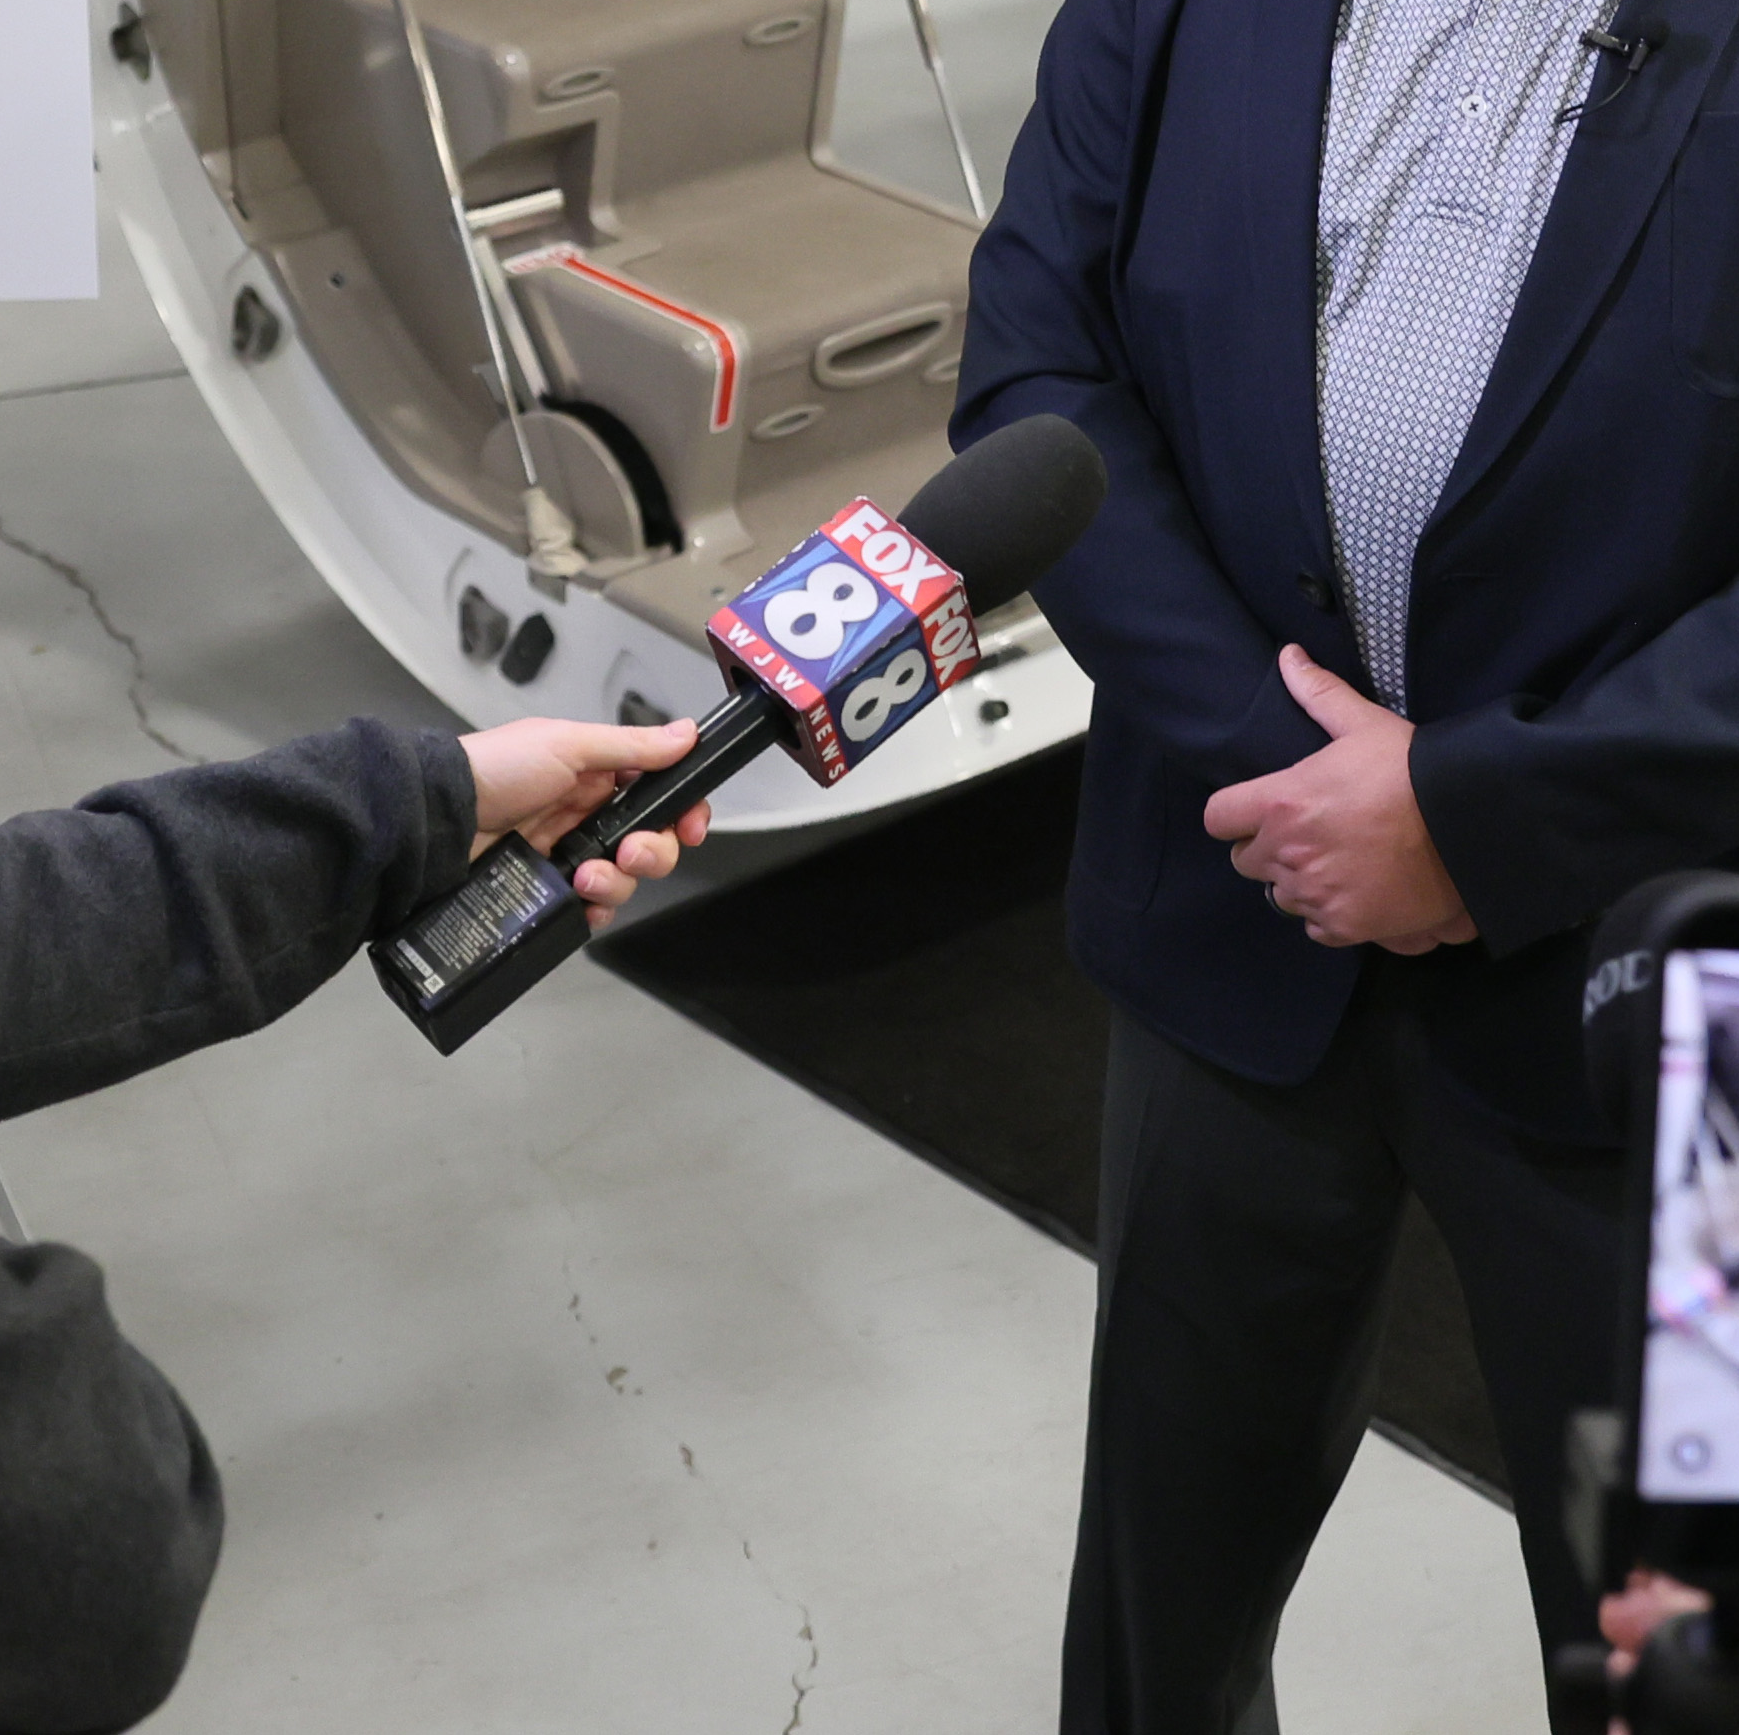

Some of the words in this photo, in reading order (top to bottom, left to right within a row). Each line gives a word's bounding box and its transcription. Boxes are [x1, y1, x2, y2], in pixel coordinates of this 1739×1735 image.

[831, 504, 947, 606] FOX
[763, 561, 880, 661] 8
[922, 591, 978, 686] FOX
[808, 703, 845, 781] NEWS
[840, 647, 928, 743] 8
